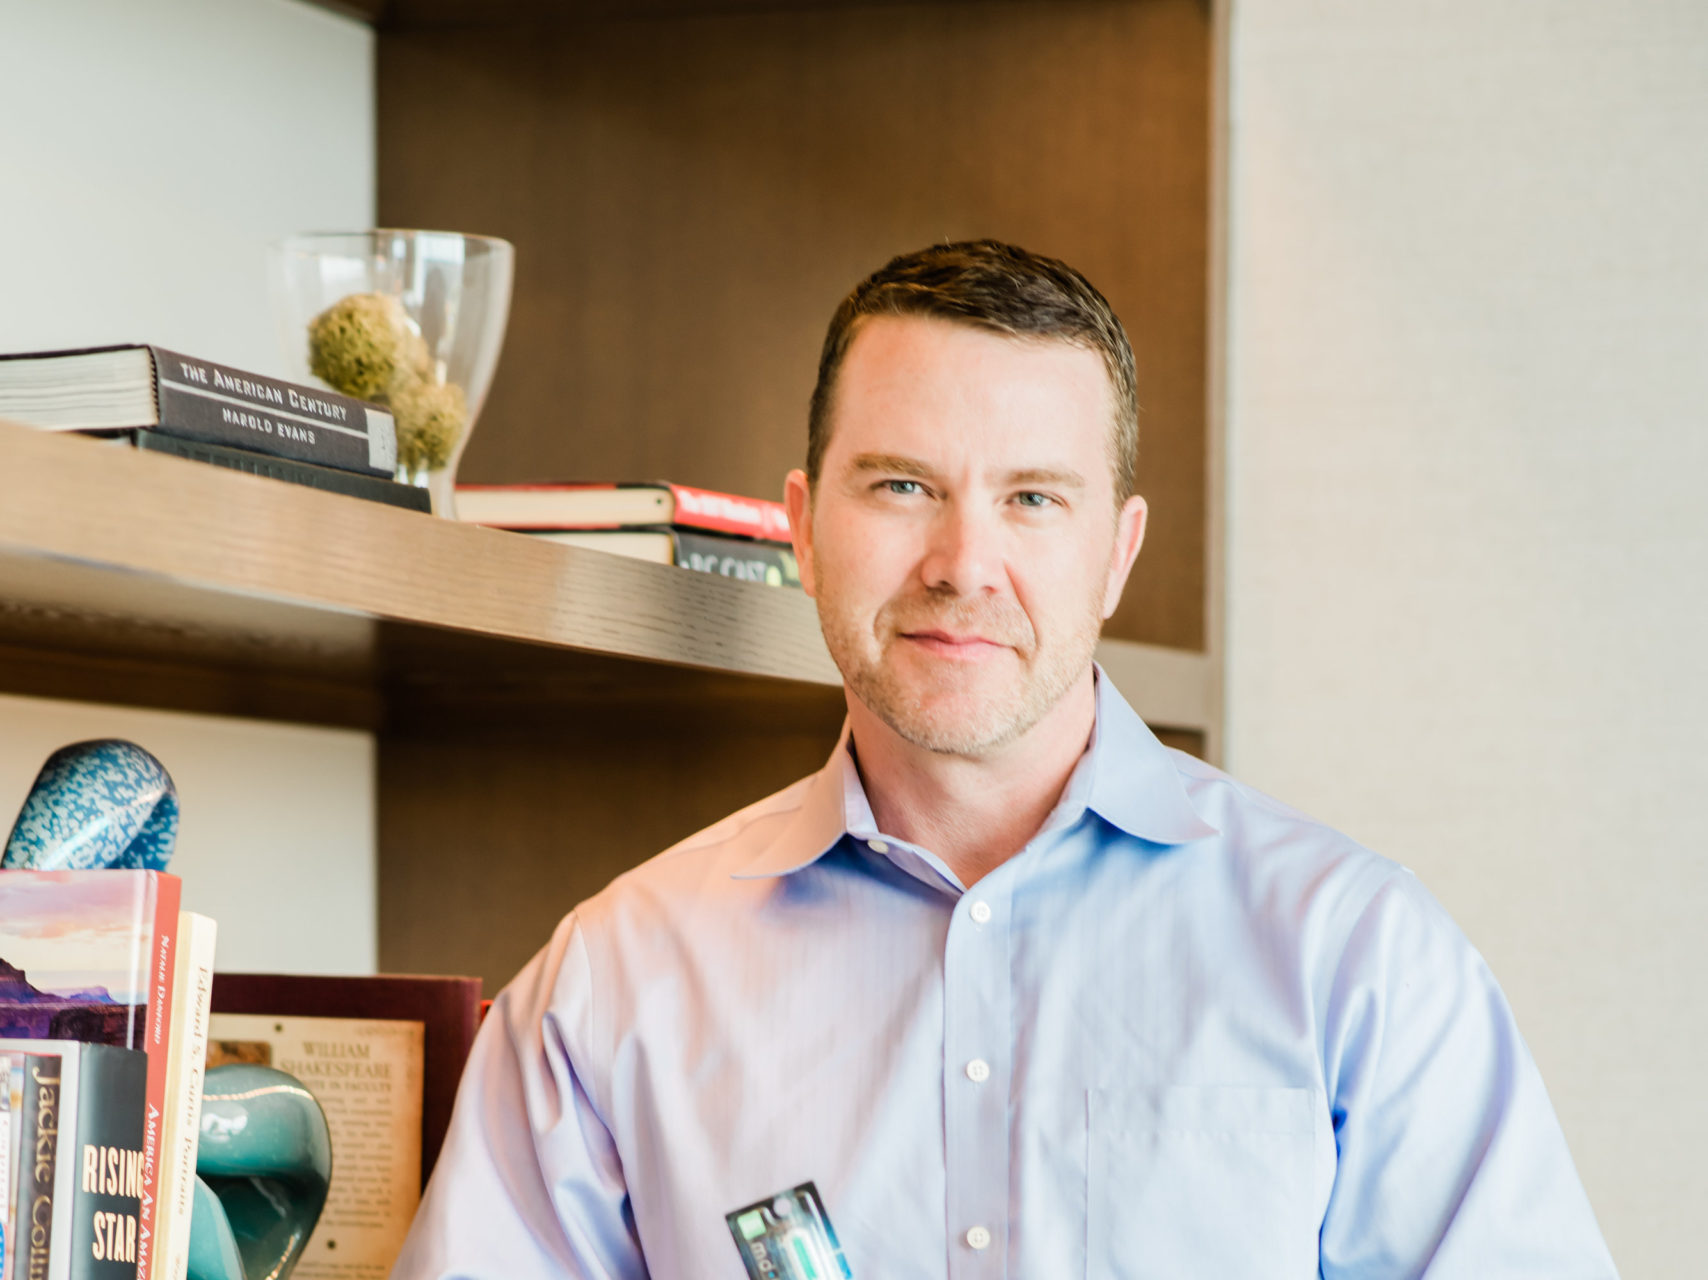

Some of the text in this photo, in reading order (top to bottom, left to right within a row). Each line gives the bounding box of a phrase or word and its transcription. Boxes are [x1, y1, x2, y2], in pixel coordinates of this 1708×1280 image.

[179, 362, 347, 421] THE AMERICAN CENTURY
[222, 408, 316, 445] HAROLD EVANS
[303, 1042, 370, 1058] WILLIAM
[32, 1066, 61, 1184] Jackie
[143, 1103, 160, 1186] AMERICA
[82, 1144, 144, 1200] RISING
[142, 1190, 154, 1221] AN
[91, 1210, 137, 1264] STAR
